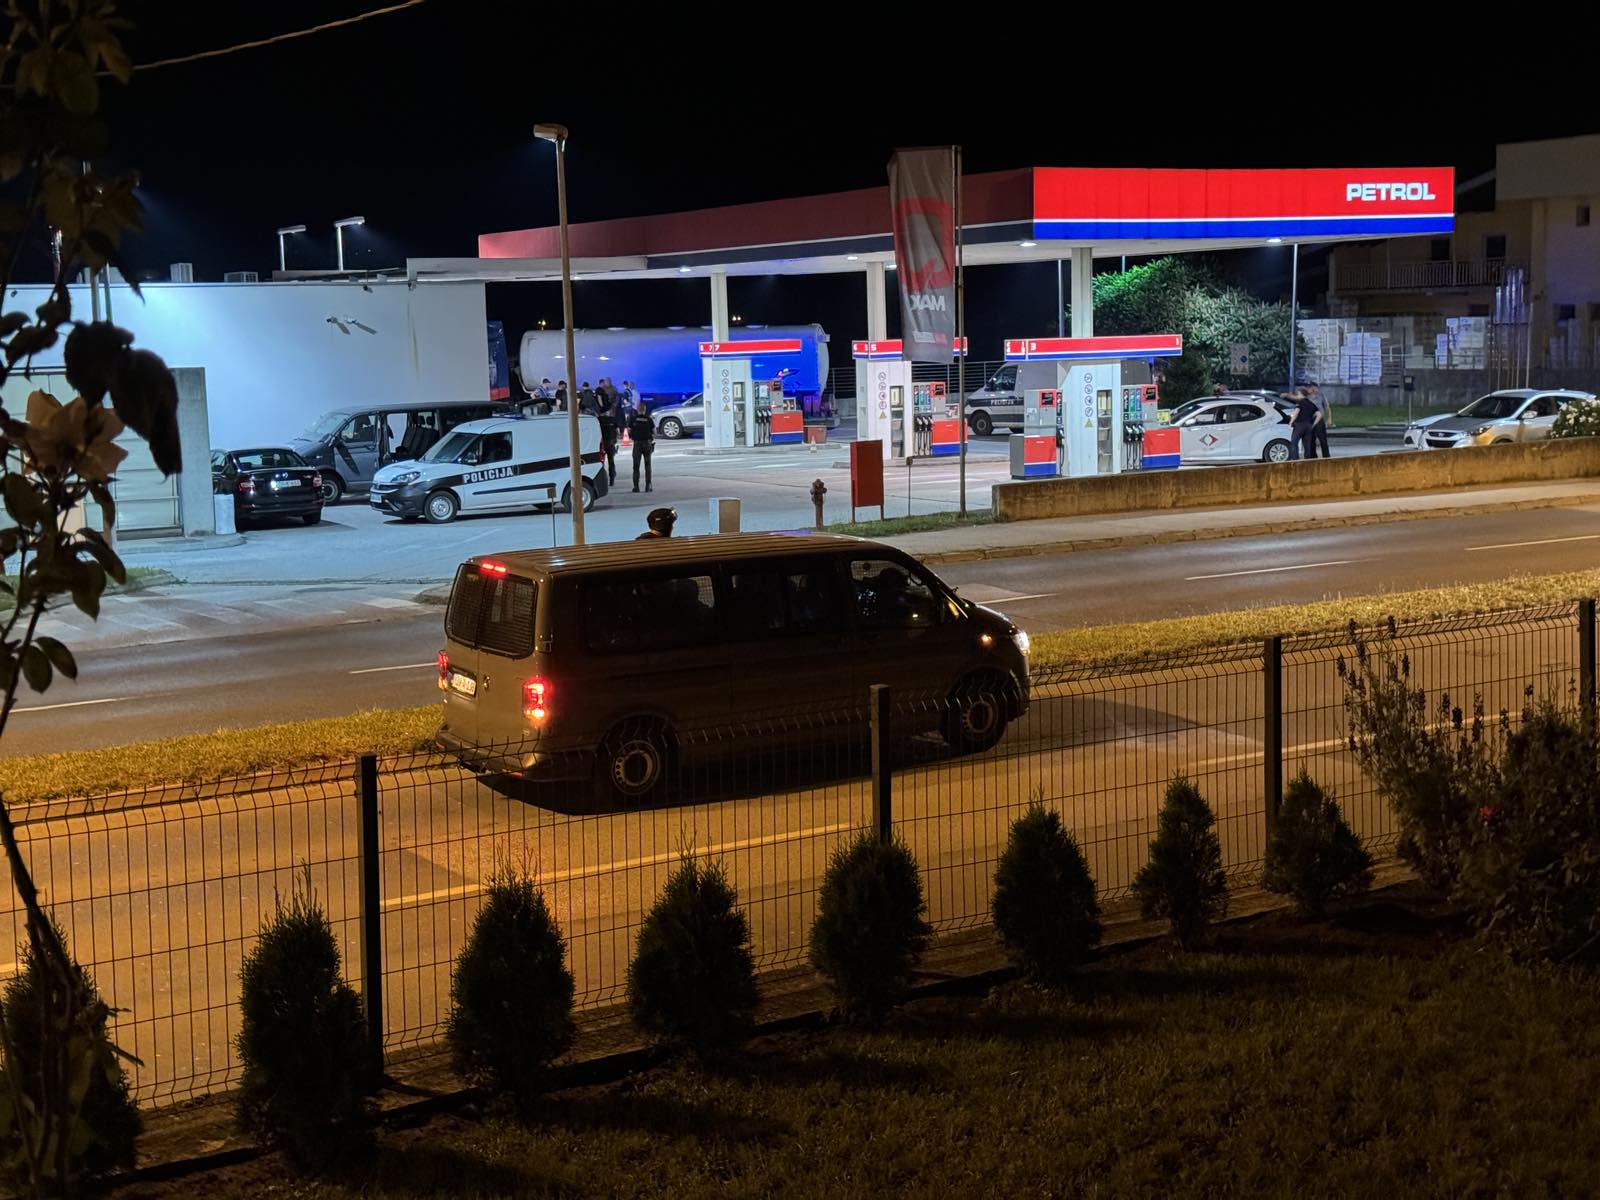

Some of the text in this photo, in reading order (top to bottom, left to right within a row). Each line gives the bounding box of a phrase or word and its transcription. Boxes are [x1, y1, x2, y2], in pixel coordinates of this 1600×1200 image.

[1346, 182, 1436, 201] PETROL
[871, 343, 877, 351] 5
[463, 466, 514, 484] POLICIJA
